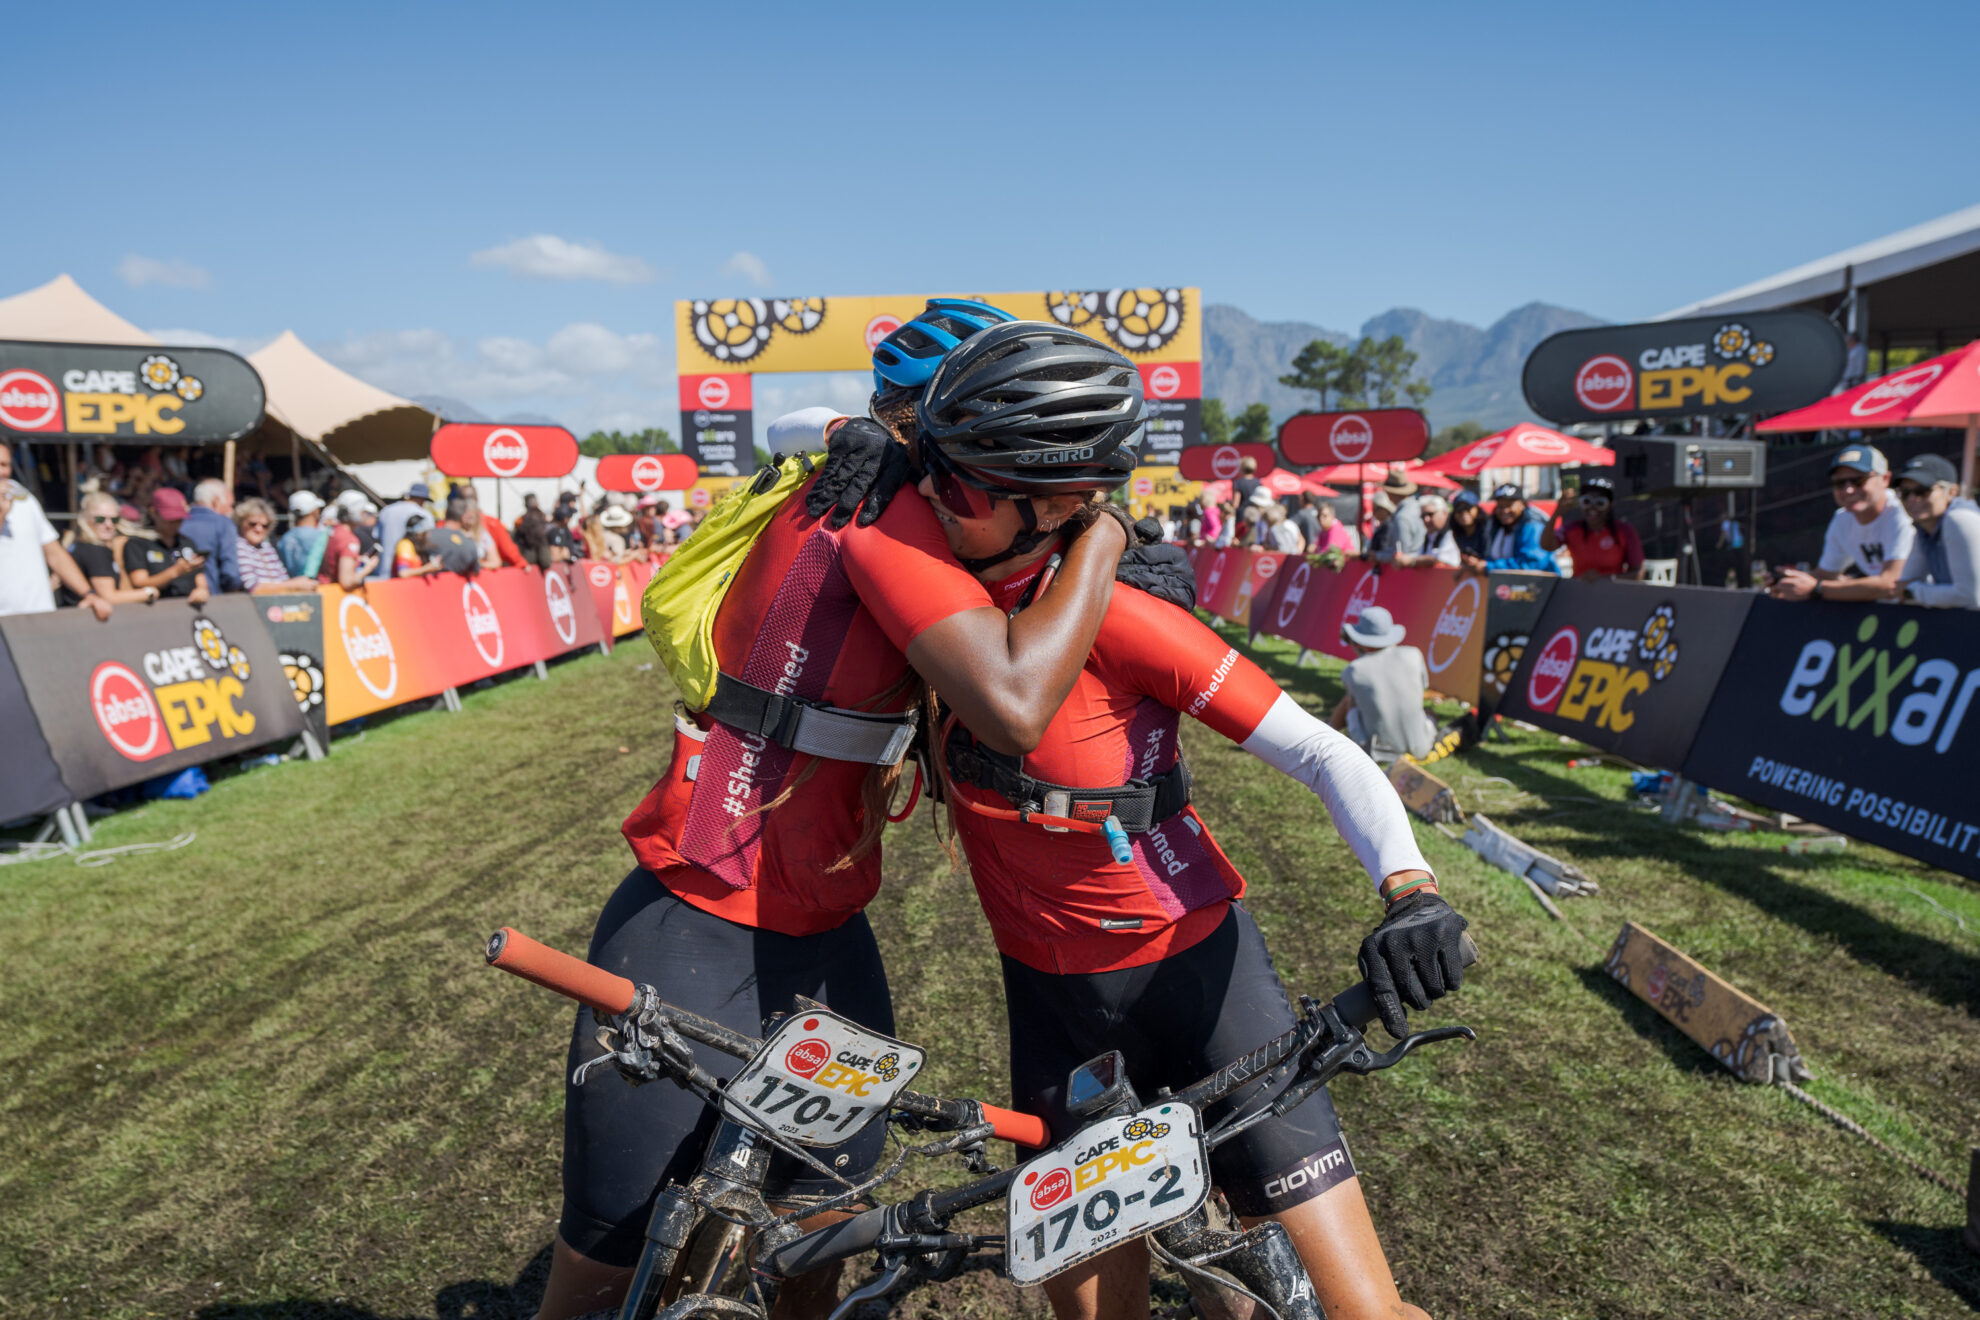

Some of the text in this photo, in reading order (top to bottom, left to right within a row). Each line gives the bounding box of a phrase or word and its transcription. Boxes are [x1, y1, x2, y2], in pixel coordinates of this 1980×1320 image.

[1639, 344, 1706, 370] CAPE
[63, 369, 136, 394] CAPE
[1582, 373, 1626, 392] absa
[1639, 363, 1753, 411] EPIC
[0, 386, 50, 409] absa
[64, 392, 187, 434] EPIC
[489, 441, 522, 460] absa
[1333, 428, 1369, 446] absa
[1043, 447, 1094, 465] GIRO
[1585, 627, 1638, 664] CAPE
[144, 646, 205, 686] CAPE
[104, 694, 150, 726] absa
[1557, 658, 1649, 733] EPIC
[154, 675, 256, 751] EPIC
[1748, 755, 1980, 858] POWERING POSSIBILIT
[794, 1048, 821, 1065] absa
[836, 1051, 874, 1071] CAPE
[814, 1062, 880, 1097] EPIC
[749, 1075, 866, 1133] 170-1
[778, 1123, 800, 1135] 2023
[1075, 1136, 1119, 1166] CAPE
[1075, 1140, 1157, 1194] EPIC
[1264, 1149, 1345, 1199] CIOVITA
[1036, 1178, 1065, 1200] absa
[1026, 1165, 1185, 1262] 170-2
[1090, 1228, 1119, 1248] 2023
